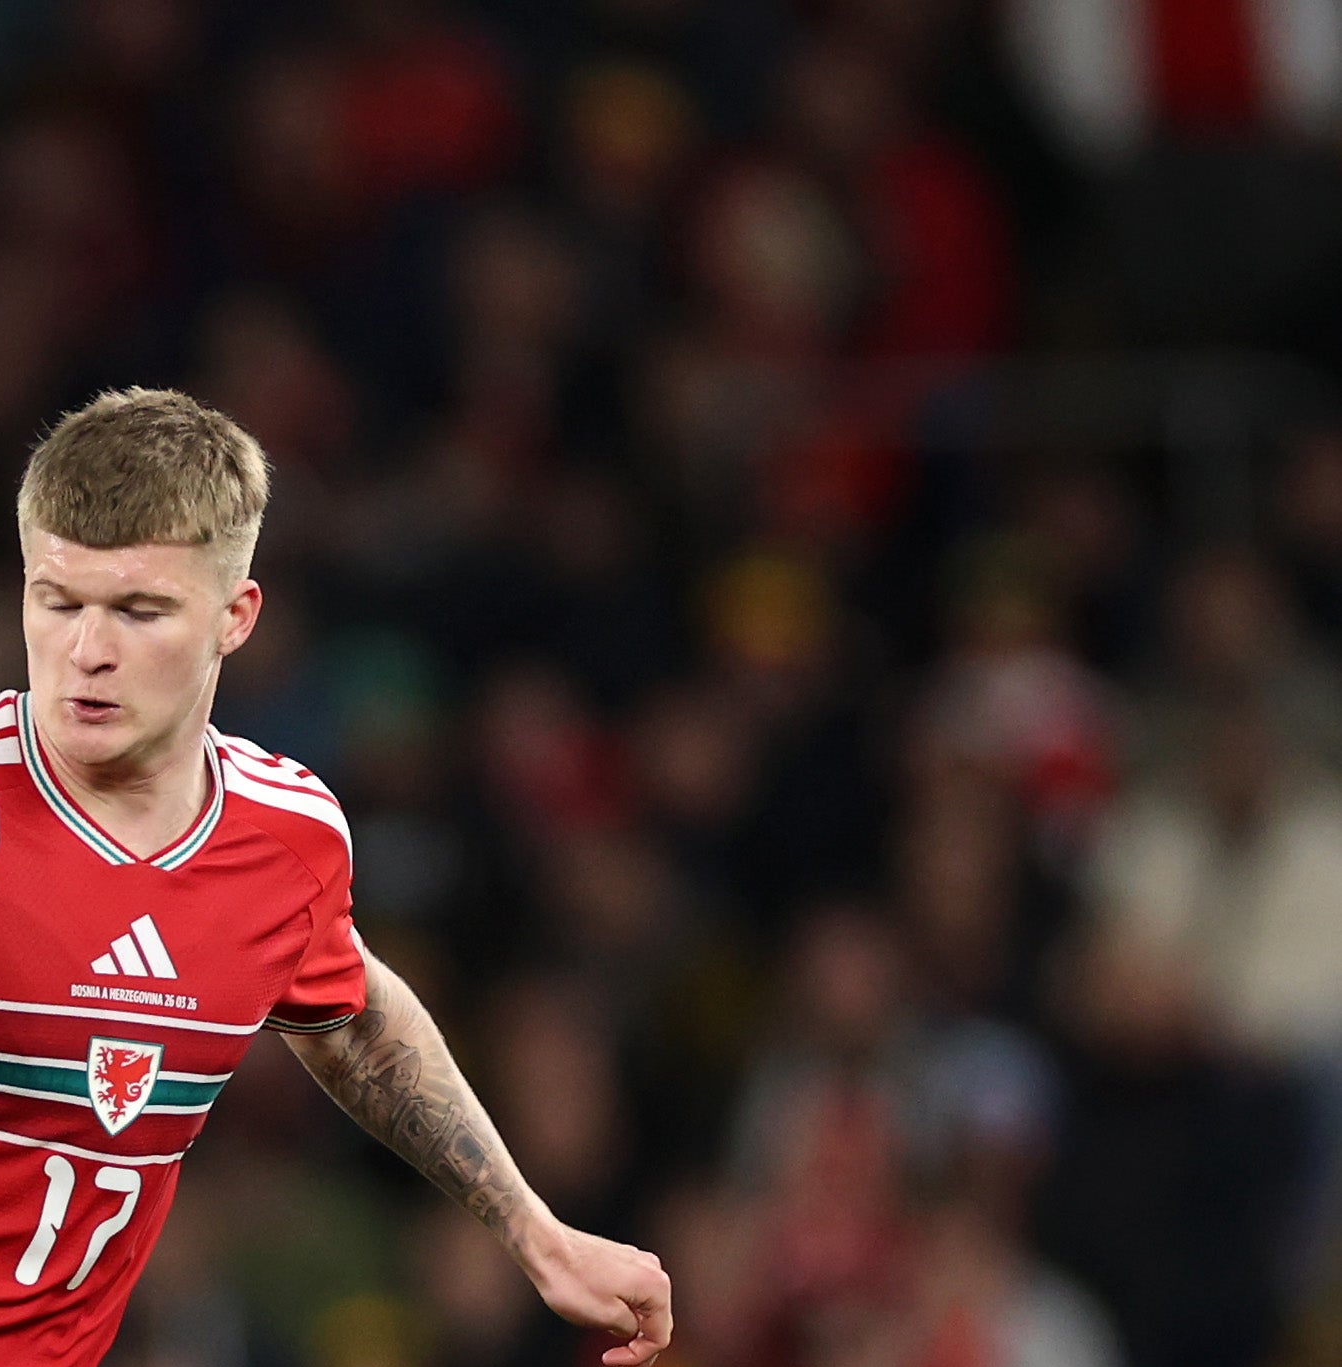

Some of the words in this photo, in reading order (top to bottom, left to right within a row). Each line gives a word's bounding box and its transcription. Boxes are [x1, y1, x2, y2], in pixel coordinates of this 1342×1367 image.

[70, 984, 101, 998] BOSNIA
[101, 986, 109, 1000] A
[109, 986, 164, 1006] HERZEGOVINA
[164, 993, 175, 1008] 26
[186, 996, 198, 1011] 26
[14, 1154, 142, 1291] 17
